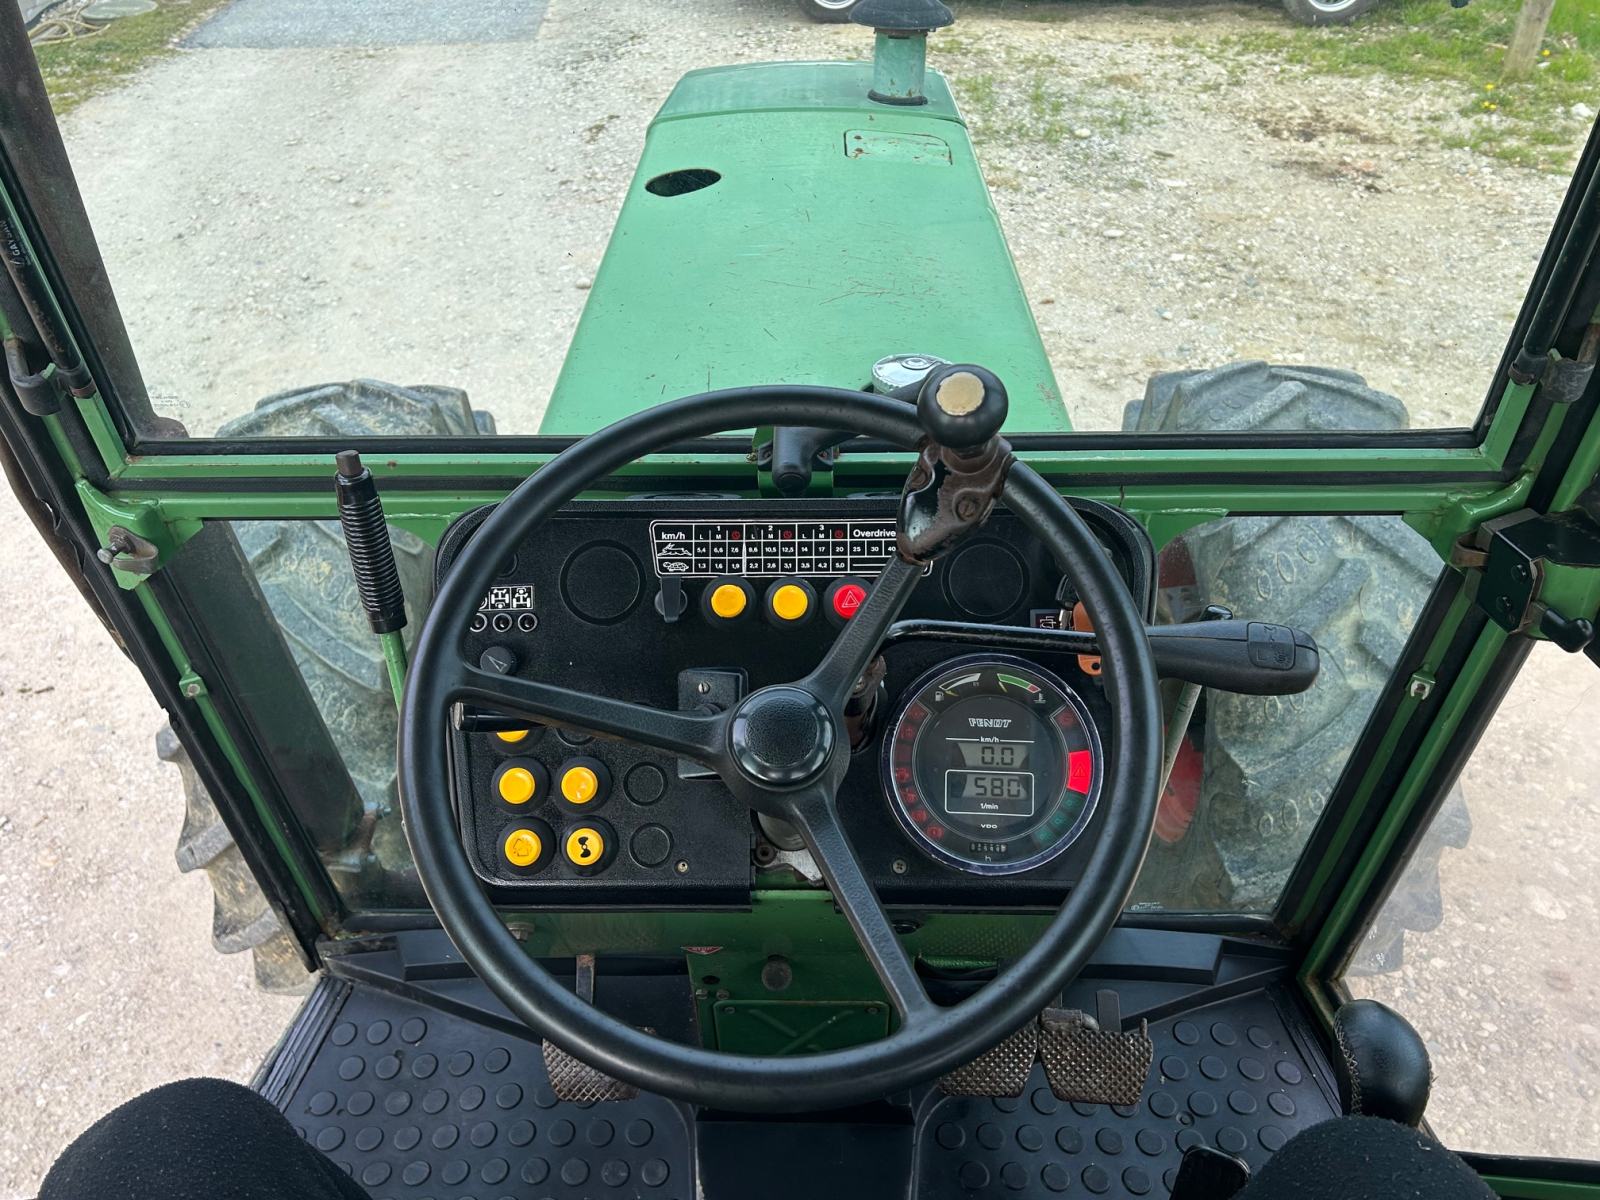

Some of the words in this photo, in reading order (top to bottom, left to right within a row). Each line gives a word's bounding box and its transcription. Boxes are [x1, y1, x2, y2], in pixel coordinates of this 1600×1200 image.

[661, 531, 686, 540] km/h
[853, 529, 897, 538] Overdrive
[968, 718, 1012, 728] FENDT
[981, 746, 1014, 766] 0.0
[974, 777, 1021, 798] 580
